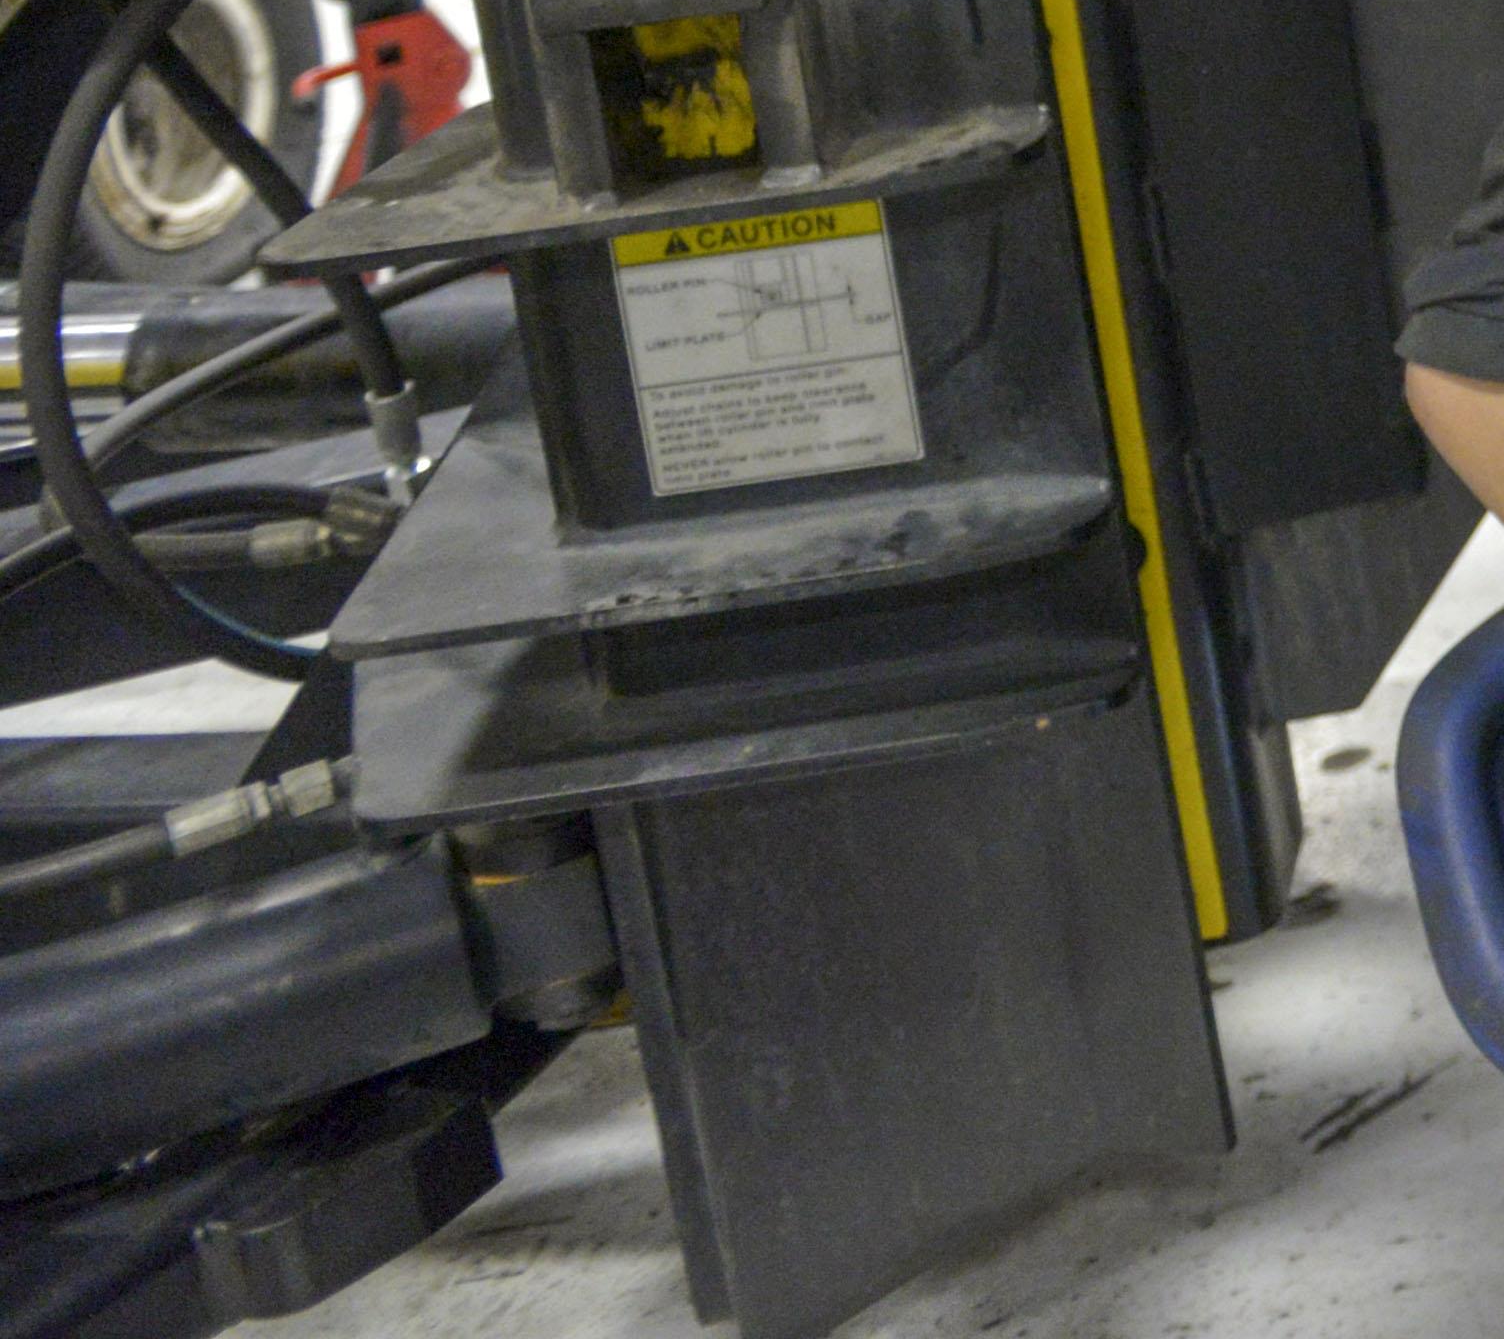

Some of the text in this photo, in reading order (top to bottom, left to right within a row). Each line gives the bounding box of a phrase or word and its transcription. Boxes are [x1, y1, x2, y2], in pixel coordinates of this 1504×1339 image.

[696, 213, 836, 250] CAUTION
[628, 278, 707, 296] ROLLER PIN
[645, 332, 726, 352] LIMIT PLATE
